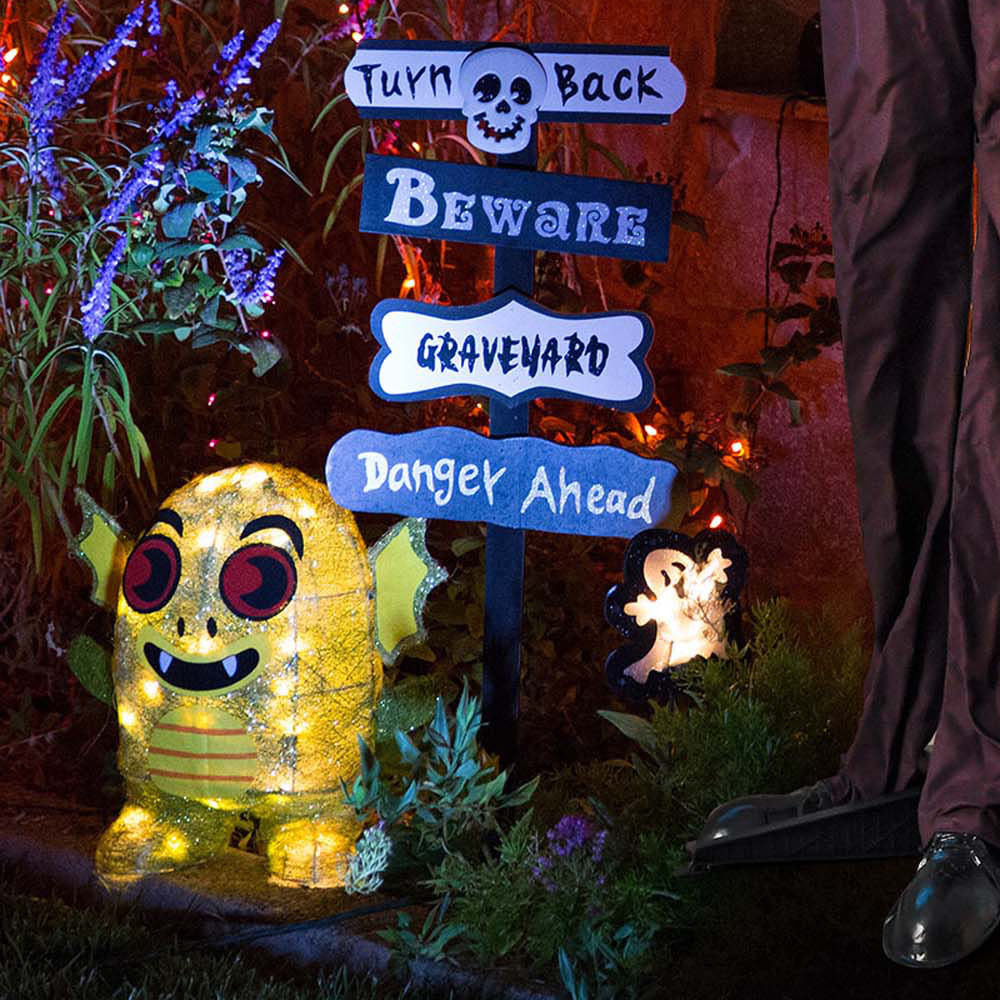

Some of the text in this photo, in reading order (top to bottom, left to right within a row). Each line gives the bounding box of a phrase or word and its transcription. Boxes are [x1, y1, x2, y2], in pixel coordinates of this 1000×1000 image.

[352, 63, 664, 106] Turn Back
[417, 332, 610, 378] GRAVEYARD
[358, 452, 656, 524] Danger Ahead
